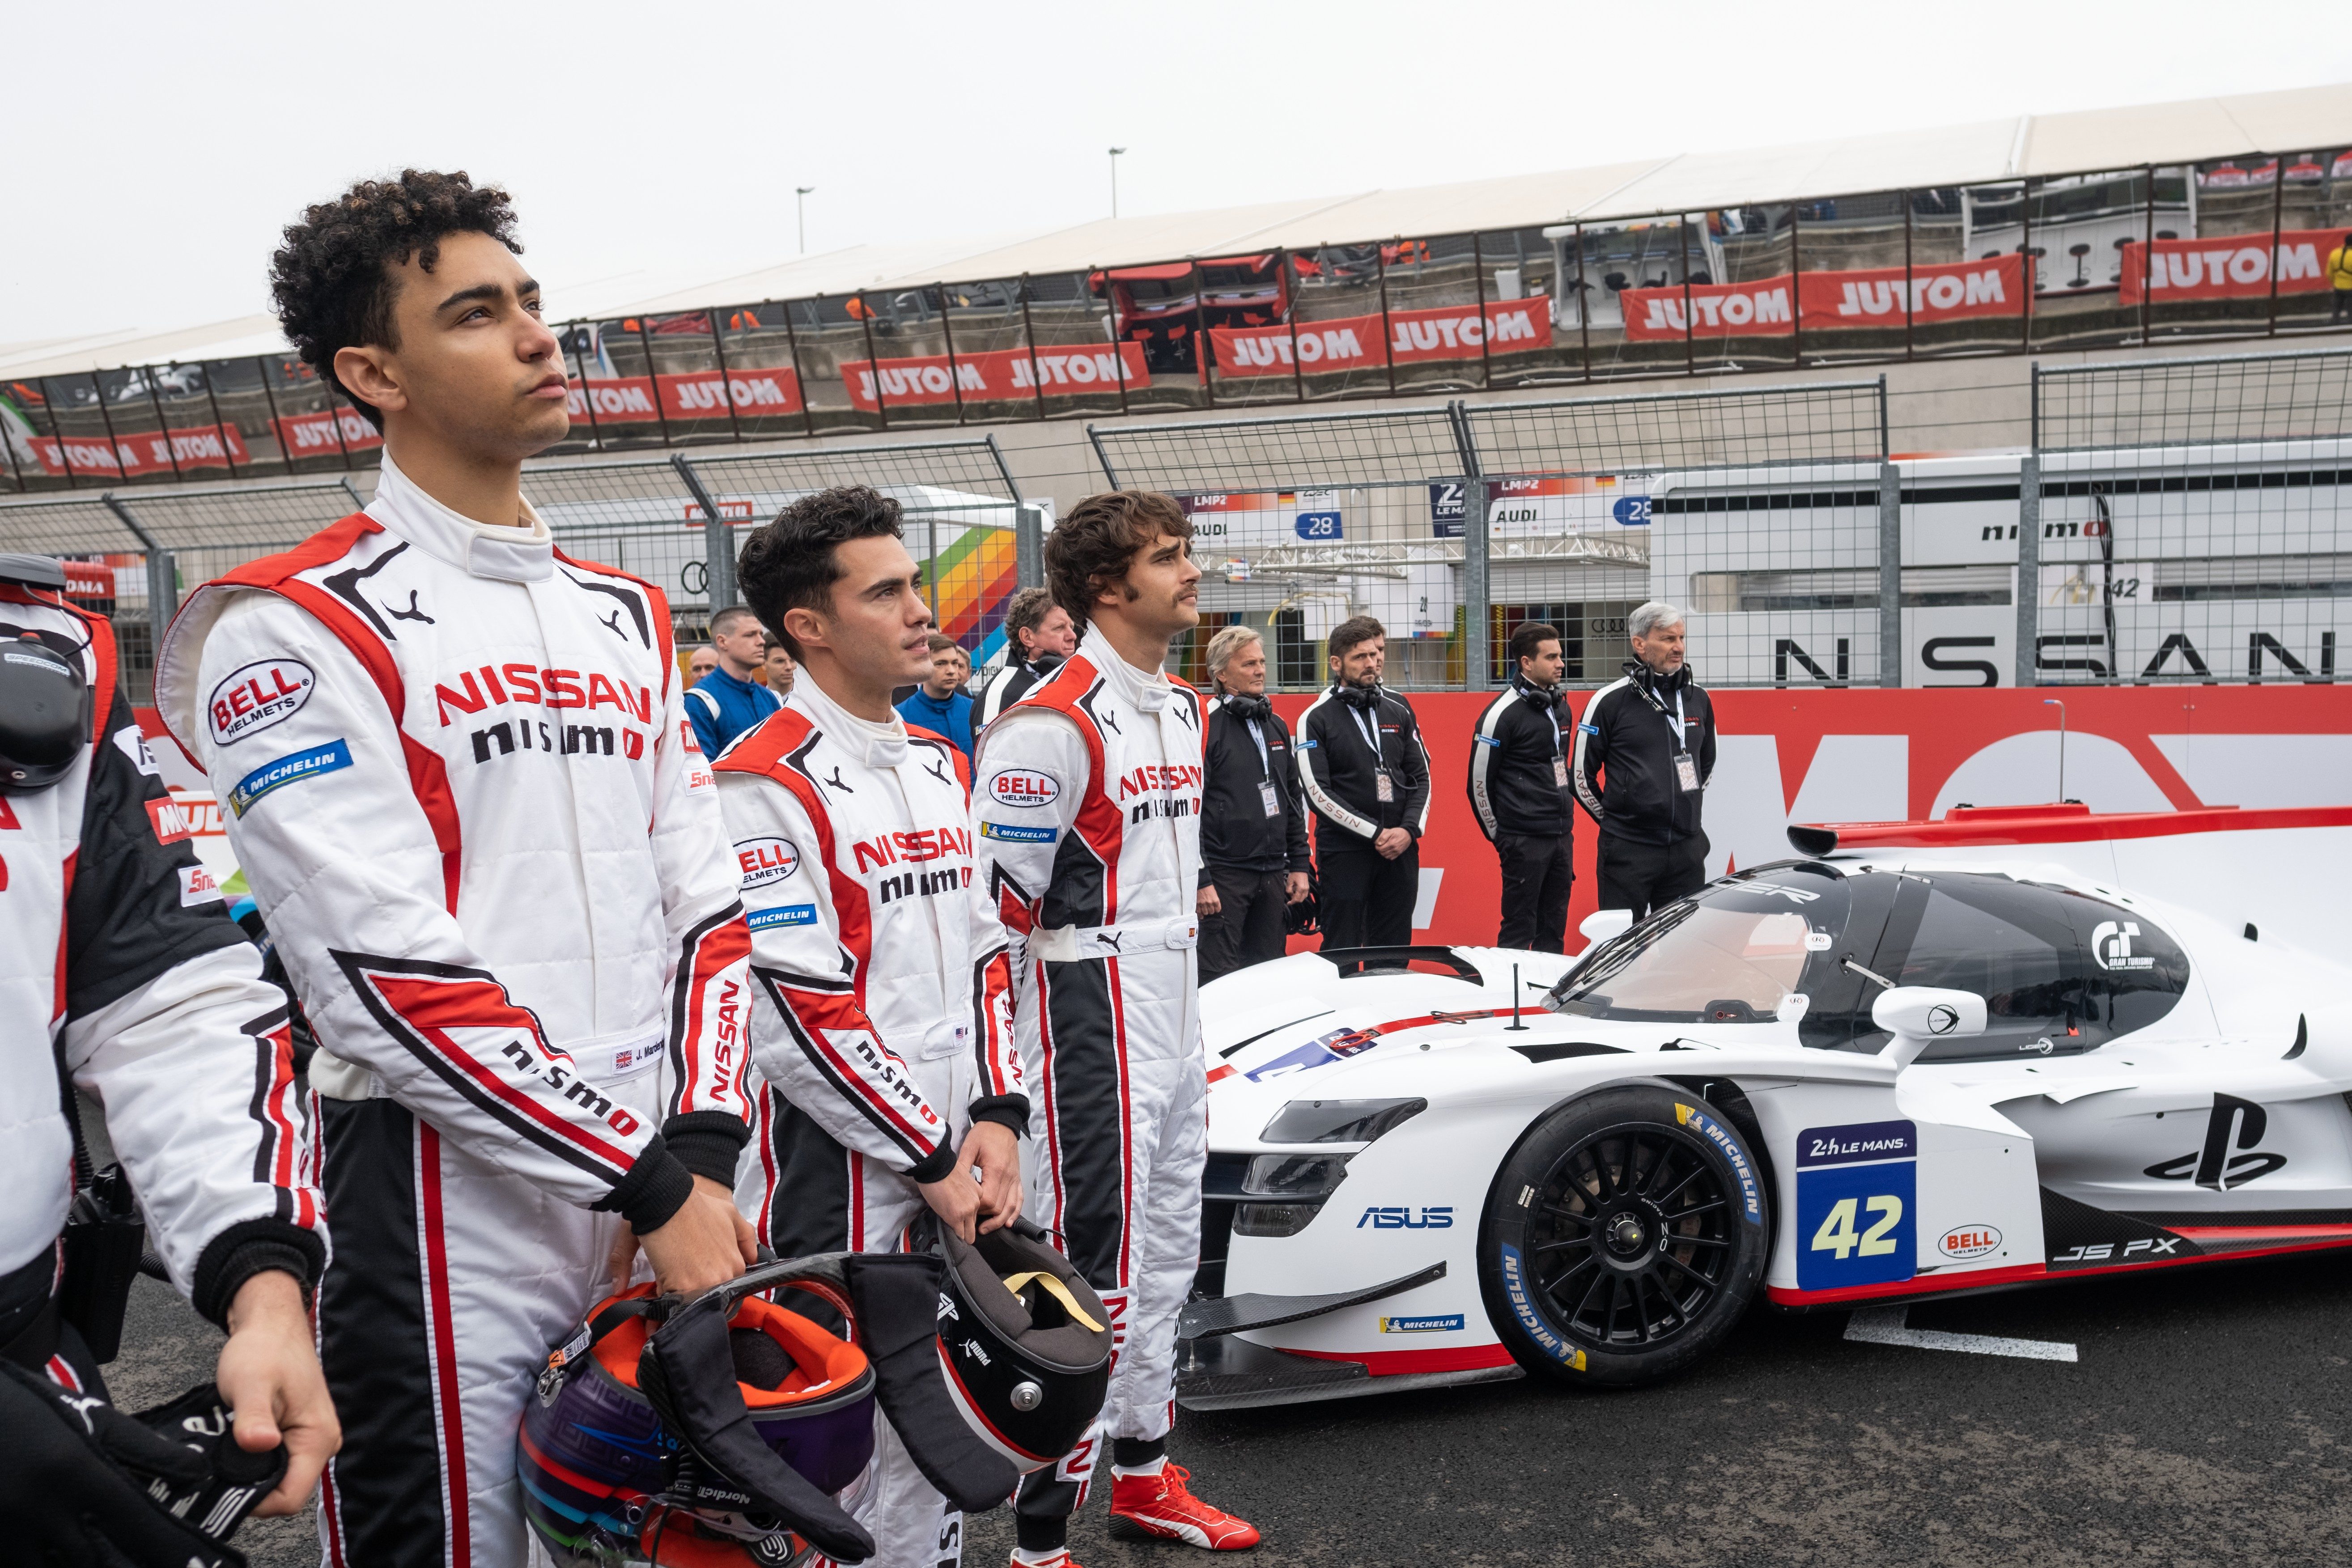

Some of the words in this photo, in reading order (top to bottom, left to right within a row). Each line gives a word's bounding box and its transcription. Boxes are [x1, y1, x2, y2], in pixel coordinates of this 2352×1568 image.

[1194, 495, 1226, 506] LMP2
[1309, 517, 1333, 535] 28
[1496, 509, 1537, 522] AUDI
[1982, 521, 2107, 540] nimo
[1775, 632, 2336, 688] NSSAN
[213, 668, 301, 732] BELL
[435, 664, 651, 727] NISSAN
[227, 697, 296, 737] HELMETS
[250, 752, 335, 793] MICHELIN
[1120, 765, 1201, 801] NISSAN
[998, 777, 1051, 795] BELL
[1002, 794, 1044, 803] HELMETS
[1309, 784, 1361, 829] NISSAN
[1477, 780, 1497, 829] NISSAN
[1001, 829, 1050, 839] MICHELIN
[739, 844, 793, 871] ELL
[853, 827, 972, 874] NISSAN
[743, 867, 787, 883] ELMETS
[749, 910, 809, 926] MICHELIN
[709, 980, 739, 1102] NISSAN
[501, 1040, 639, 1137] nismo
[856, 1040, 937, 1125] nismo
[1841, 1141, 1860, 1154] LE
[1861, 1138, 1904, 1152] MANS
[1705, 1124, 1758, 1215] MICHELIN
[1356, 1207, 1453, 1228] ASUS
[1641, 1198, 1663, 1216] RACING
[1811, 1194, 1903, 1260] 42
[1947, 1231, 1993, 1250] BELL
[1953, 1246, 1987, 1254] HELMETS
[2053, 1243, 2114, 1261] JS
[2123, 1238, 2181, 1257] PX
[1506, 1255, 1560, 1349] MICHELIN
[1403, 1318, 1458, 1330] MICHELIN
